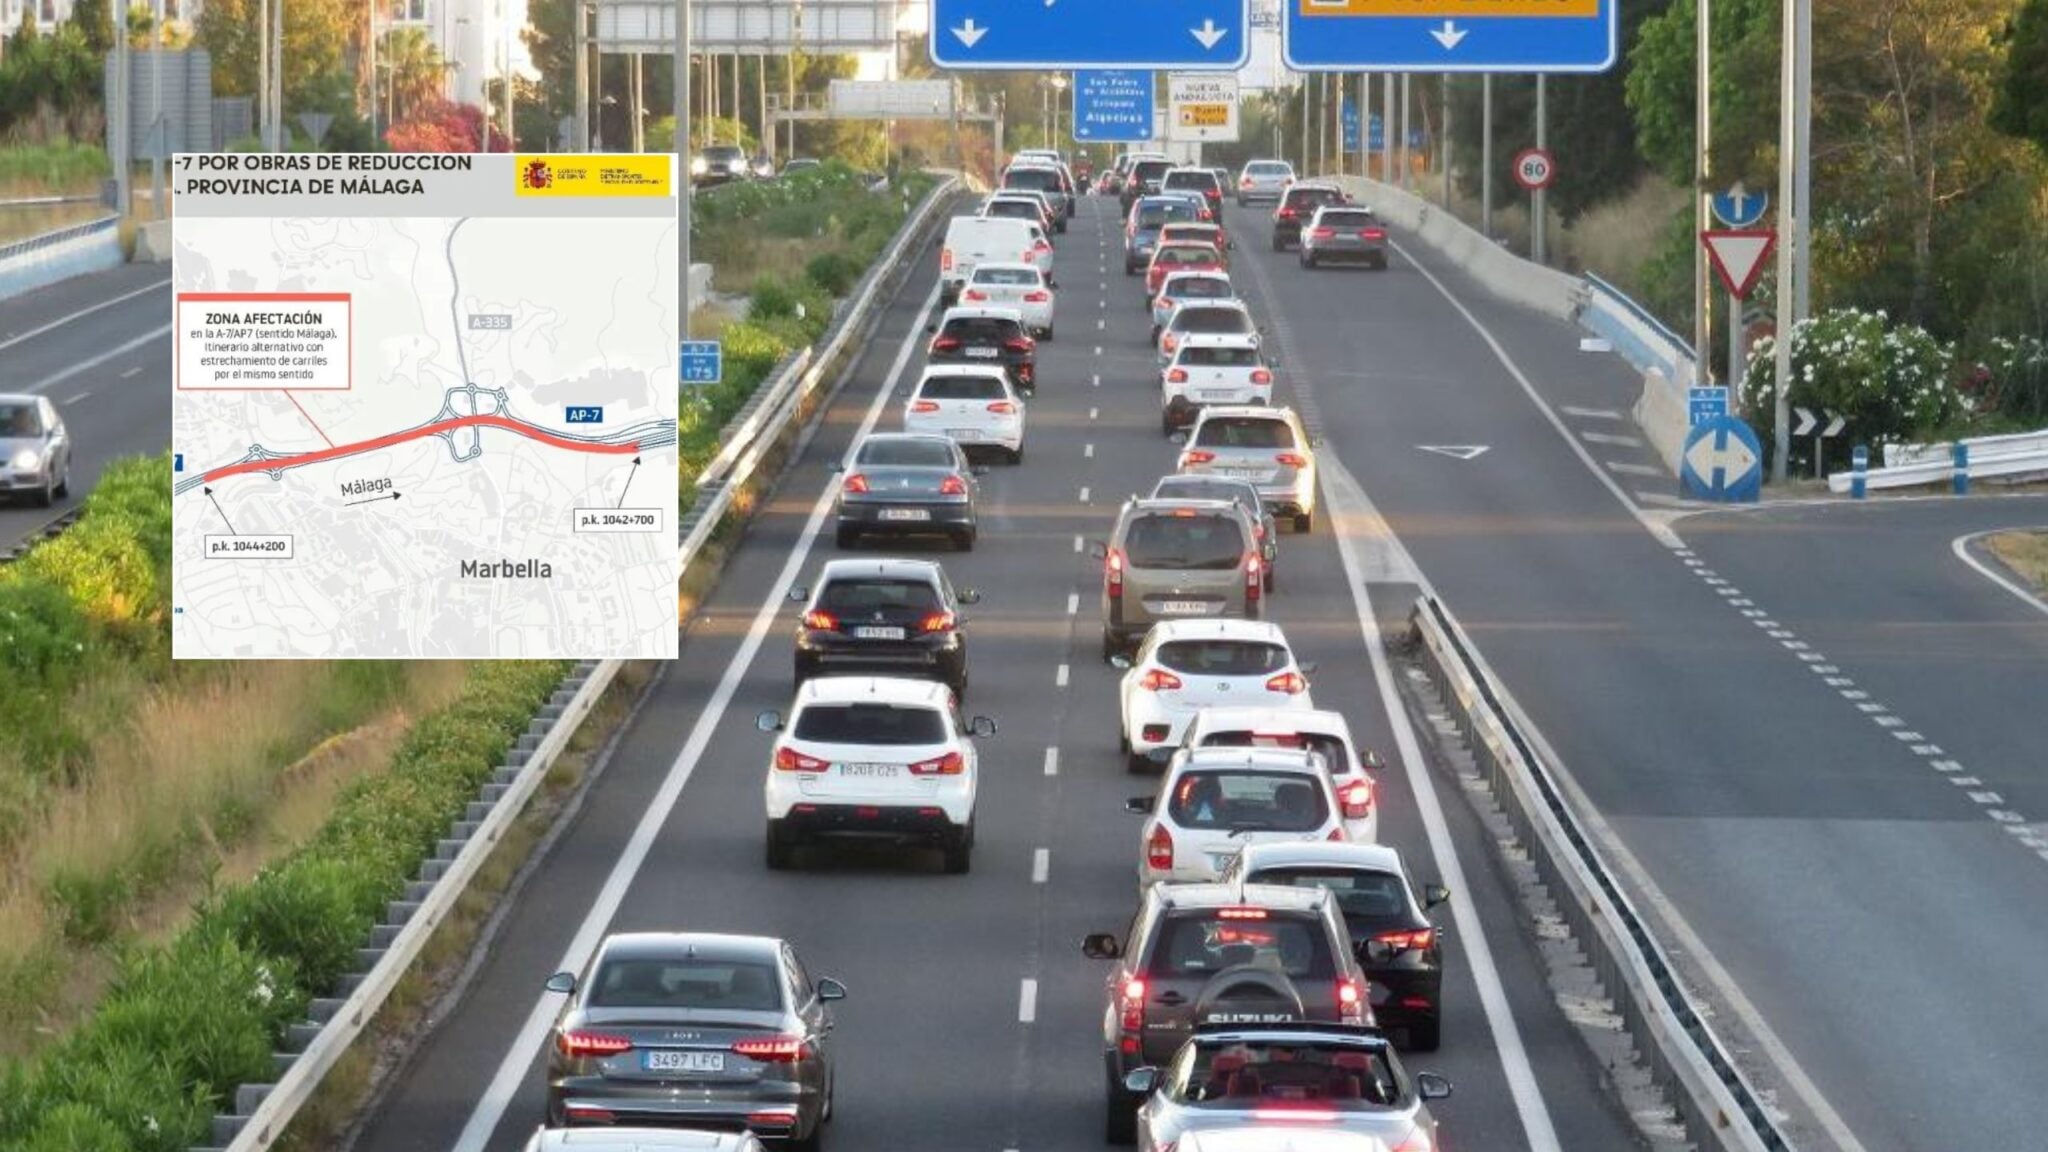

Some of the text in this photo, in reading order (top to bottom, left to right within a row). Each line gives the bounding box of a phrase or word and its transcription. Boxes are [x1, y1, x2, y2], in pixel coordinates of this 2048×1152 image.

[1524, 162, 1546, 177] 80
[1208, 1013, 1292, 1024] SUZUKI
[652, 1053, 689, 1067] 3497
